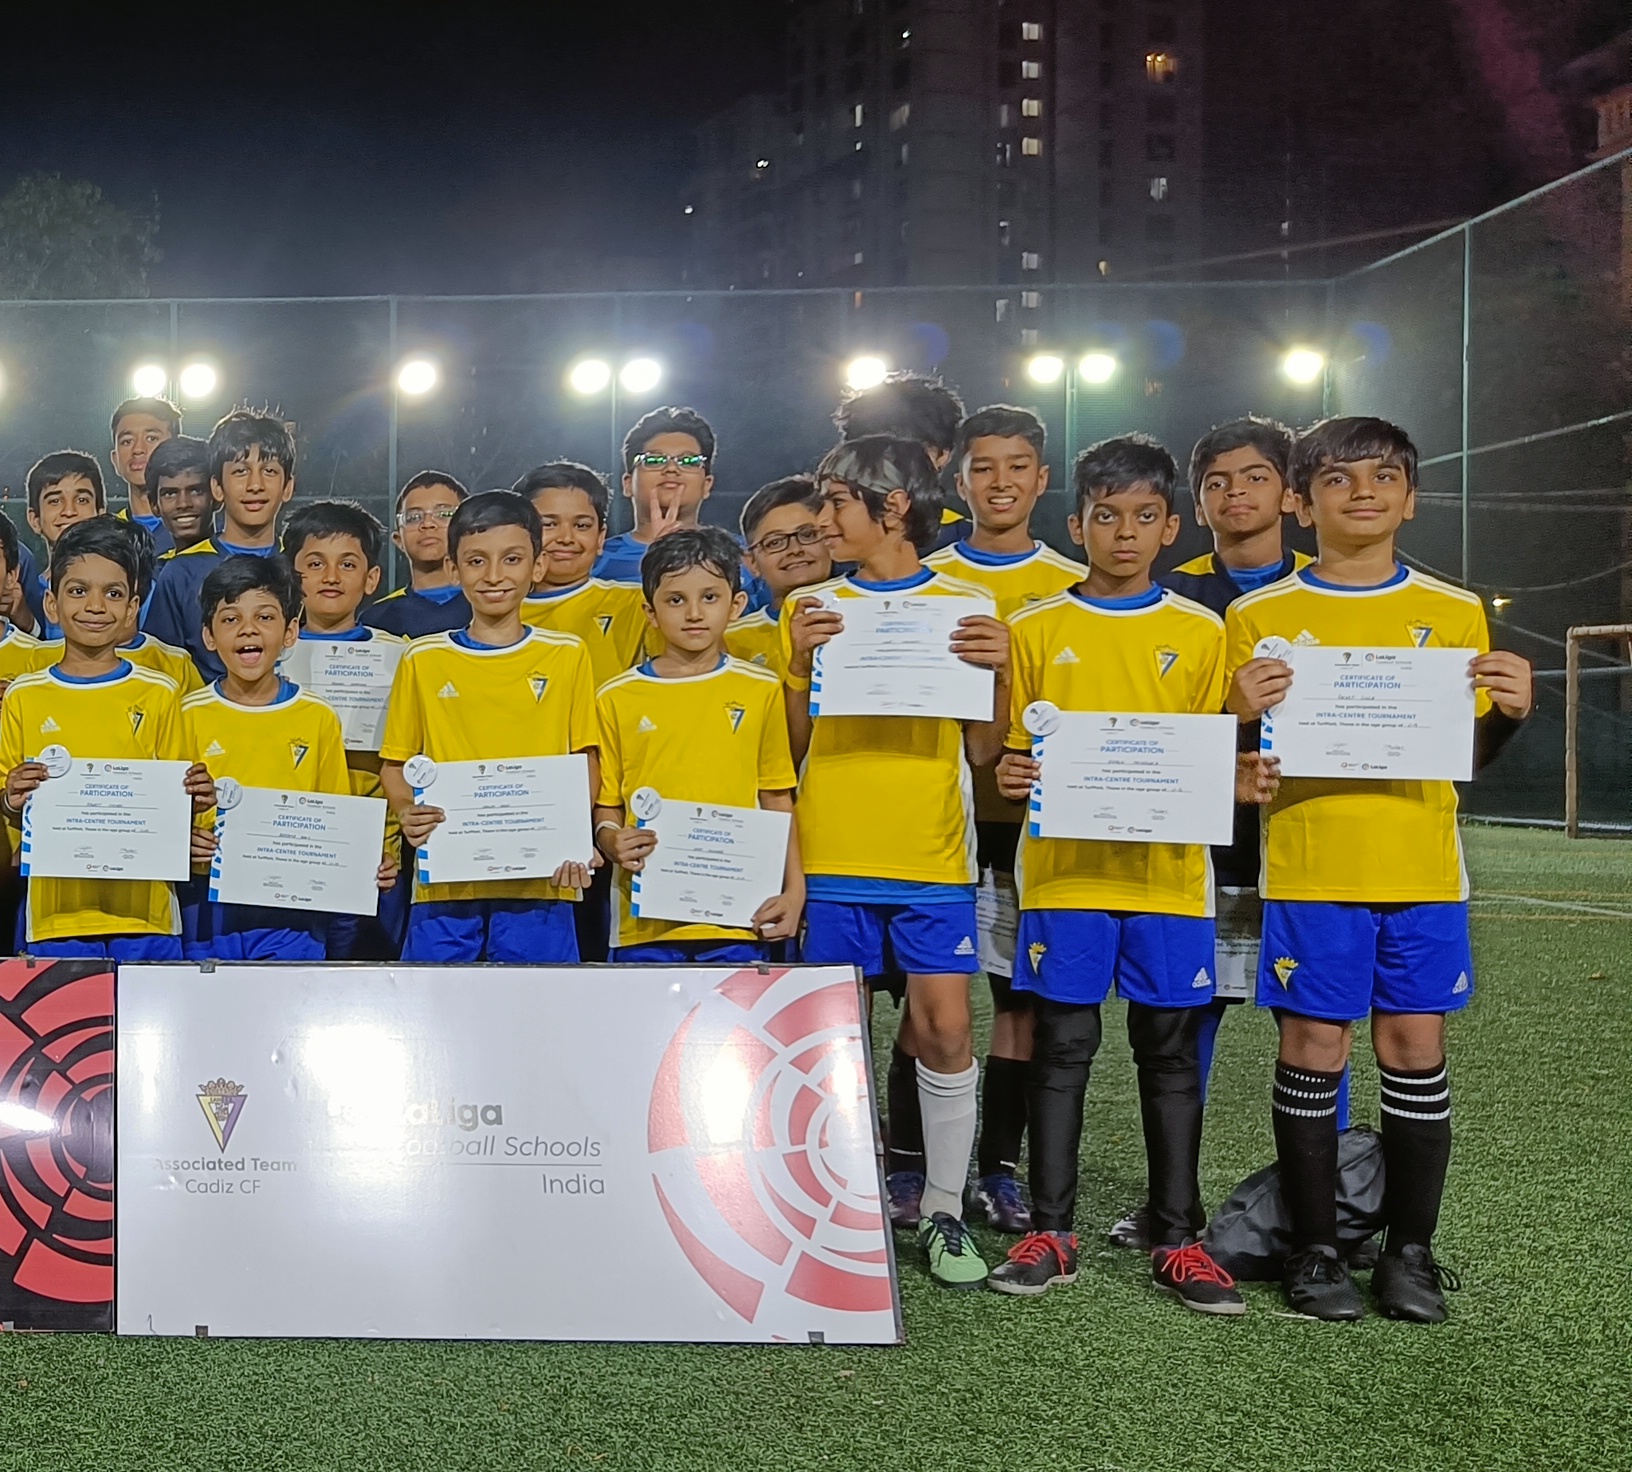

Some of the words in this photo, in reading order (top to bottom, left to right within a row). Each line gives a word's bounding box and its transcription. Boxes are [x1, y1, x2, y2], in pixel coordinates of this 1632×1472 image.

[1334, 681, 1401, 689] PARTICIPATION
[1101, 746, 1164, 754] PARTICIPATION
[474, 789, 529, 799] PARTICIPATION
[273, 820, 326, 831] PARTICIPATION
[504, 1136, 601, 1157] Schools
[154, 1157, 245, 1171] Associated
[250, 1158, 297, 1172] Team
[186, 1179, 234, 1194] Cadiz
[240, 1180, 261, 1194] CF
[542, 1174, 605, 1195] India
